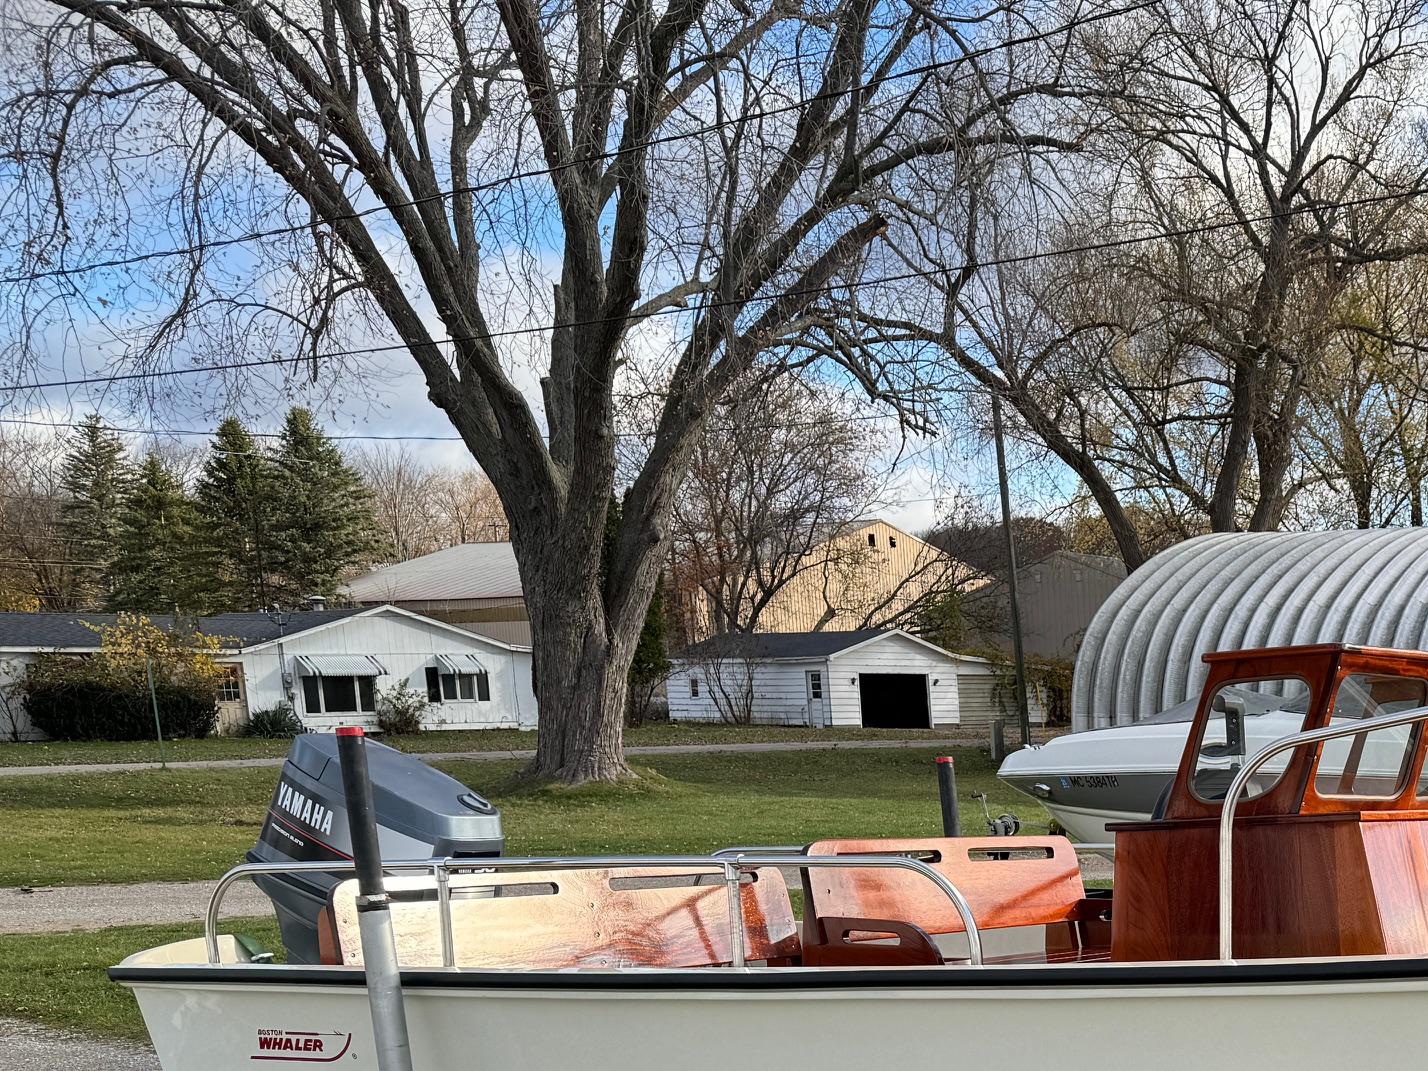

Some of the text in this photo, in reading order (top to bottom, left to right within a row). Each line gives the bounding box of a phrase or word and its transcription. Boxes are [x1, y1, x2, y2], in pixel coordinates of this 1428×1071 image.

[277, 781, 334, 836] YAMAHA
[257, 1028, 283, 1036] BOSTON
[258, 1037, 324, 1052] WHALER
